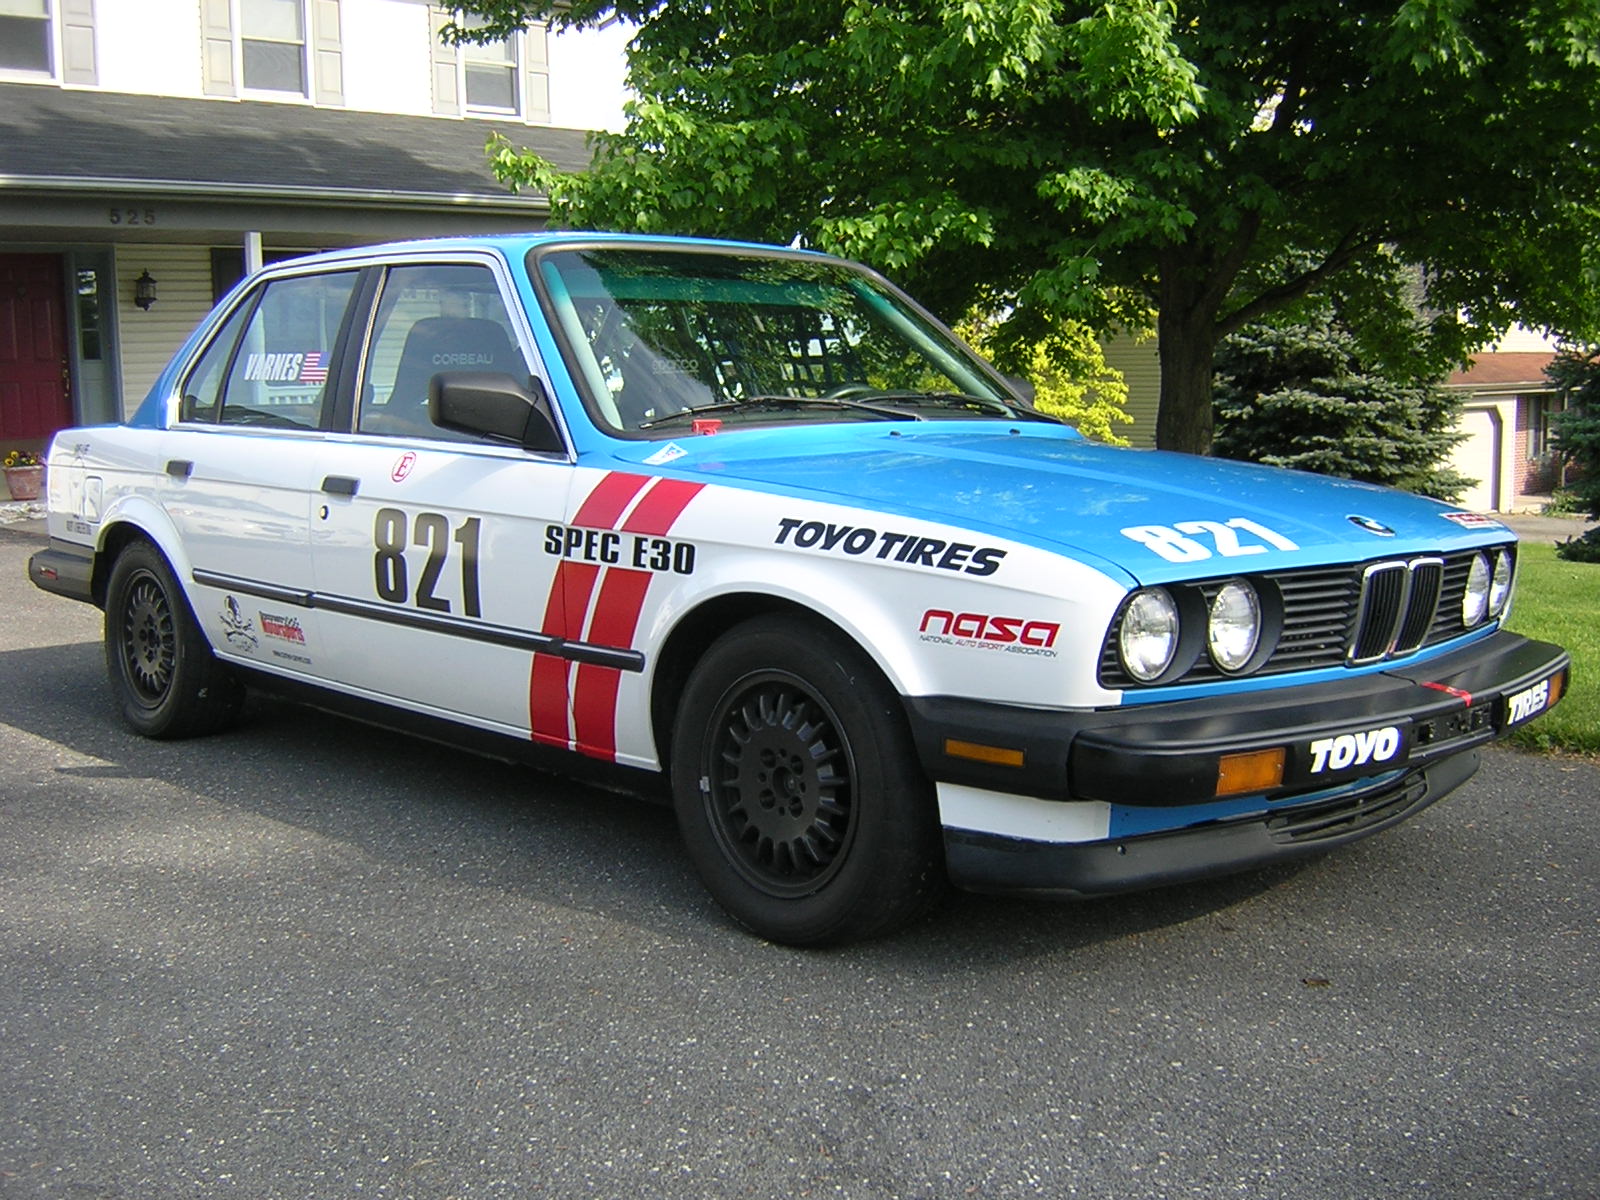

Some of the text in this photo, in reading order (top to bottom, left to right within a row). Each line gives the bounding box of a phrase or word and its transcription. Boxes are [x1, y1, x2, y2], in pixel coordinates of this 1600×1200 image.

[109, 208, 155, 225] 525
[244, 353, 304, 381] VARNES
[432, 353, 494, 366] CORBEAU
[375, 507, 482, 619] 821
[544, 524, 696, 575] SPEC E30
[774, 517, 1008, 577] TOYO TIRES
[1120, 517, 1300, 563] 821
[919, 634, 1058, 658] NATIONAL AUTO SPORT ASSOCIATION
[1506, 679, 1549, 726] TIRES
[1310, 726, 1400, 774] TOYO
